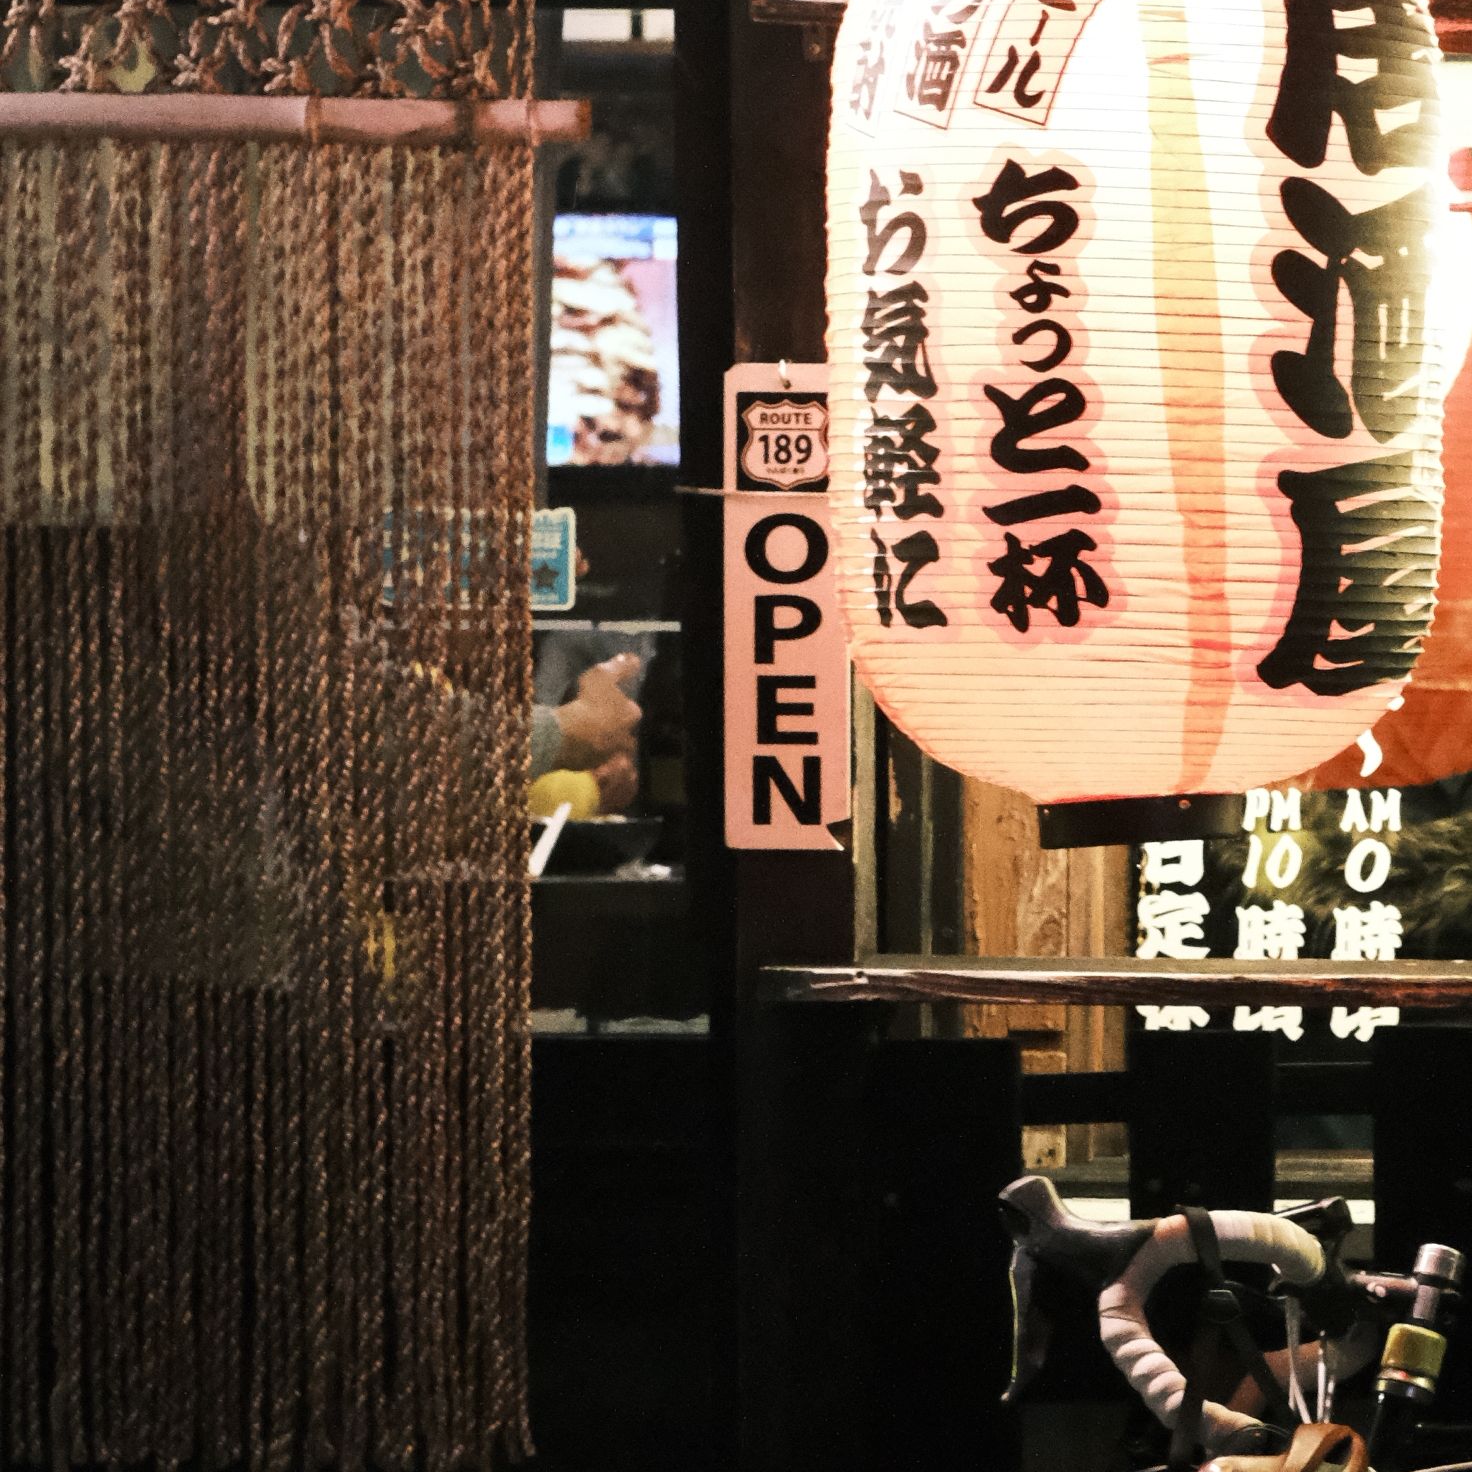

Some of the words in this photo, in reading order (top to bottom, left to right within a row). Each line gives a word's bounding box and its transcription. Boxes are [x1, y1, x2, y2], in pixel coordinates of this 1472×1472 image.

[758, 434, 813, 465] 189
[759, 412, 813, 425] ROUTE
[858, 165, 949, 629] お気軽に
[971, 158, 1110, 634] ちょっと一杯
[744, 512, 829, 826] OPEN
